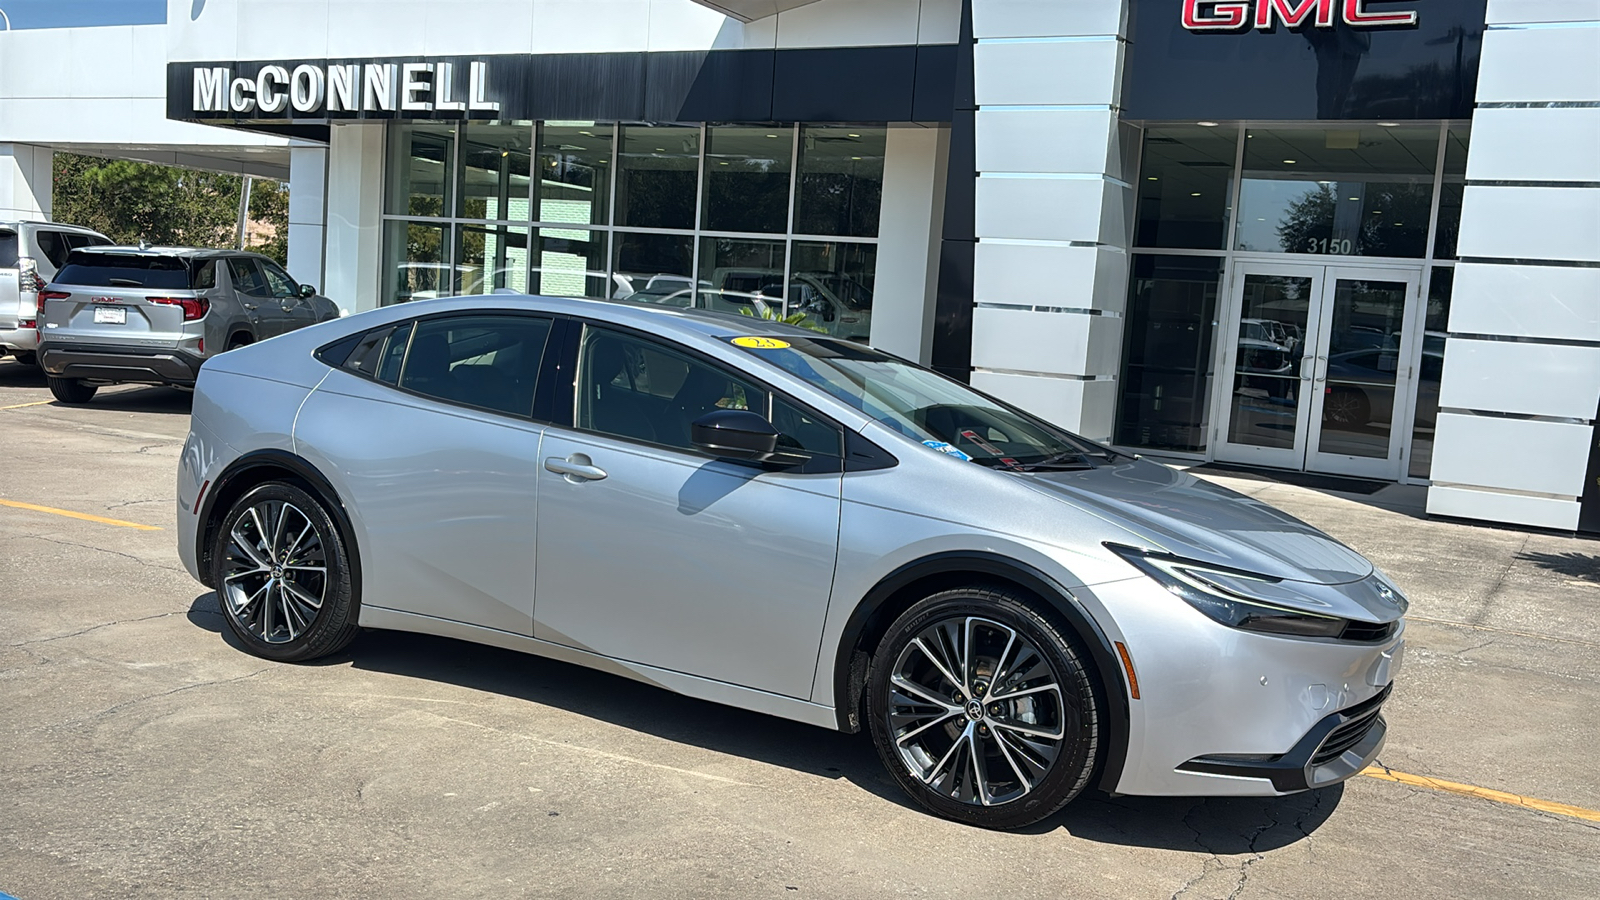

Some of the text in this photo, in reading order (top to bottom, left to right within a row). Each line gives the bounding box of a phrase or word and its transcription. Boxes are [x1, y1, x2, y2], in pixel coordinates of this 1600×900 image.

[192, 61, 500, 112] McCONNELL
[1307, 237, 1352, 255] 3150
[91, 296, 124, 304] GMC
